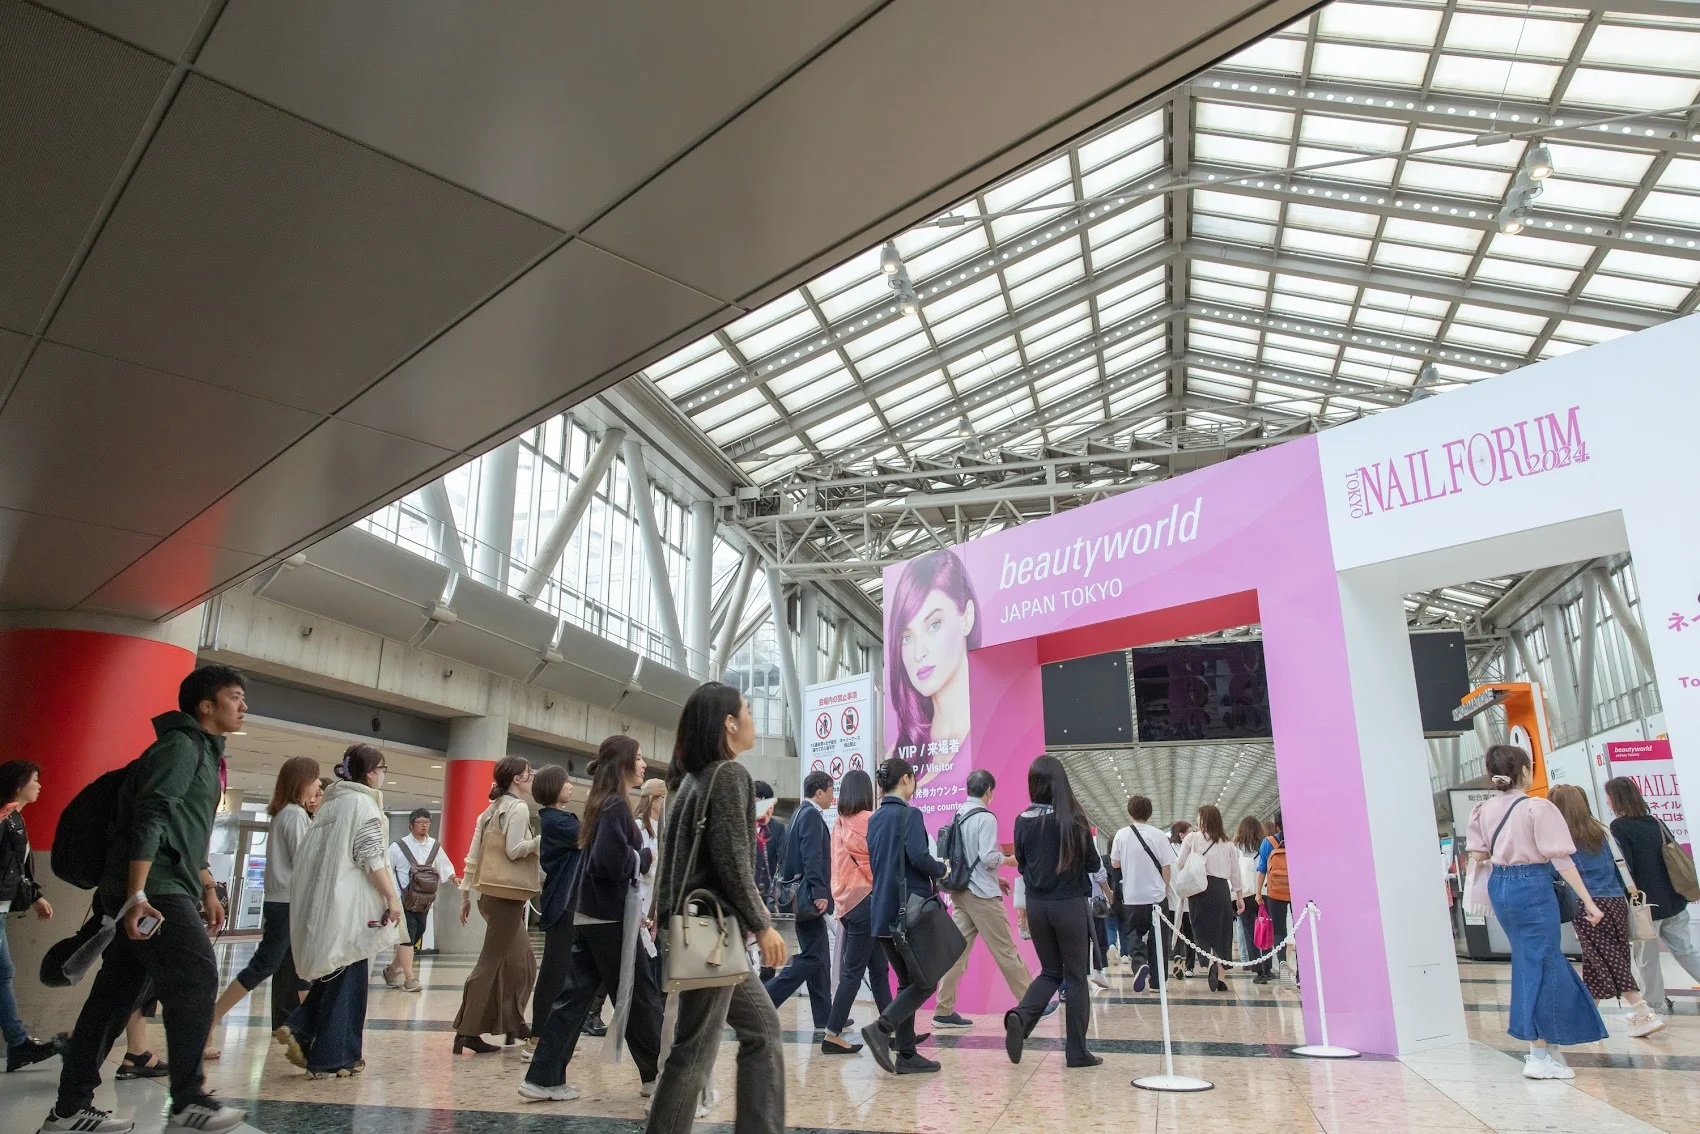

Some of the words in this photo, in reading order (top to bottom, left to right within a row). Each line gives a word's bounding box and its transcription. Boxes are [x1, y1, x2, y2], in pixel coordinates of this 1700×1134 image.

[1358, 449, 1447, 517] NAIL
[1442, 406, 1587, 494] FORUM
[1527, 441, 1591, 476] 2024
[1345, 469, 1364, 519] TOKYO
[999, 496, 1203, 590] beautyworld
[1000, 594, 1056, 624] JAPAN
[1061, 578, 1123, 609] TOKYO
[898, 745, 918, 759] VIP
[920, 744, 925, 757] /
[927, 738, 960, 756] 来場者
[1614, 745, 1653, 753] beautyworld
[926, 762, 954, 773] Visitor
[911, 785, 966, 799] 発券カウンター
